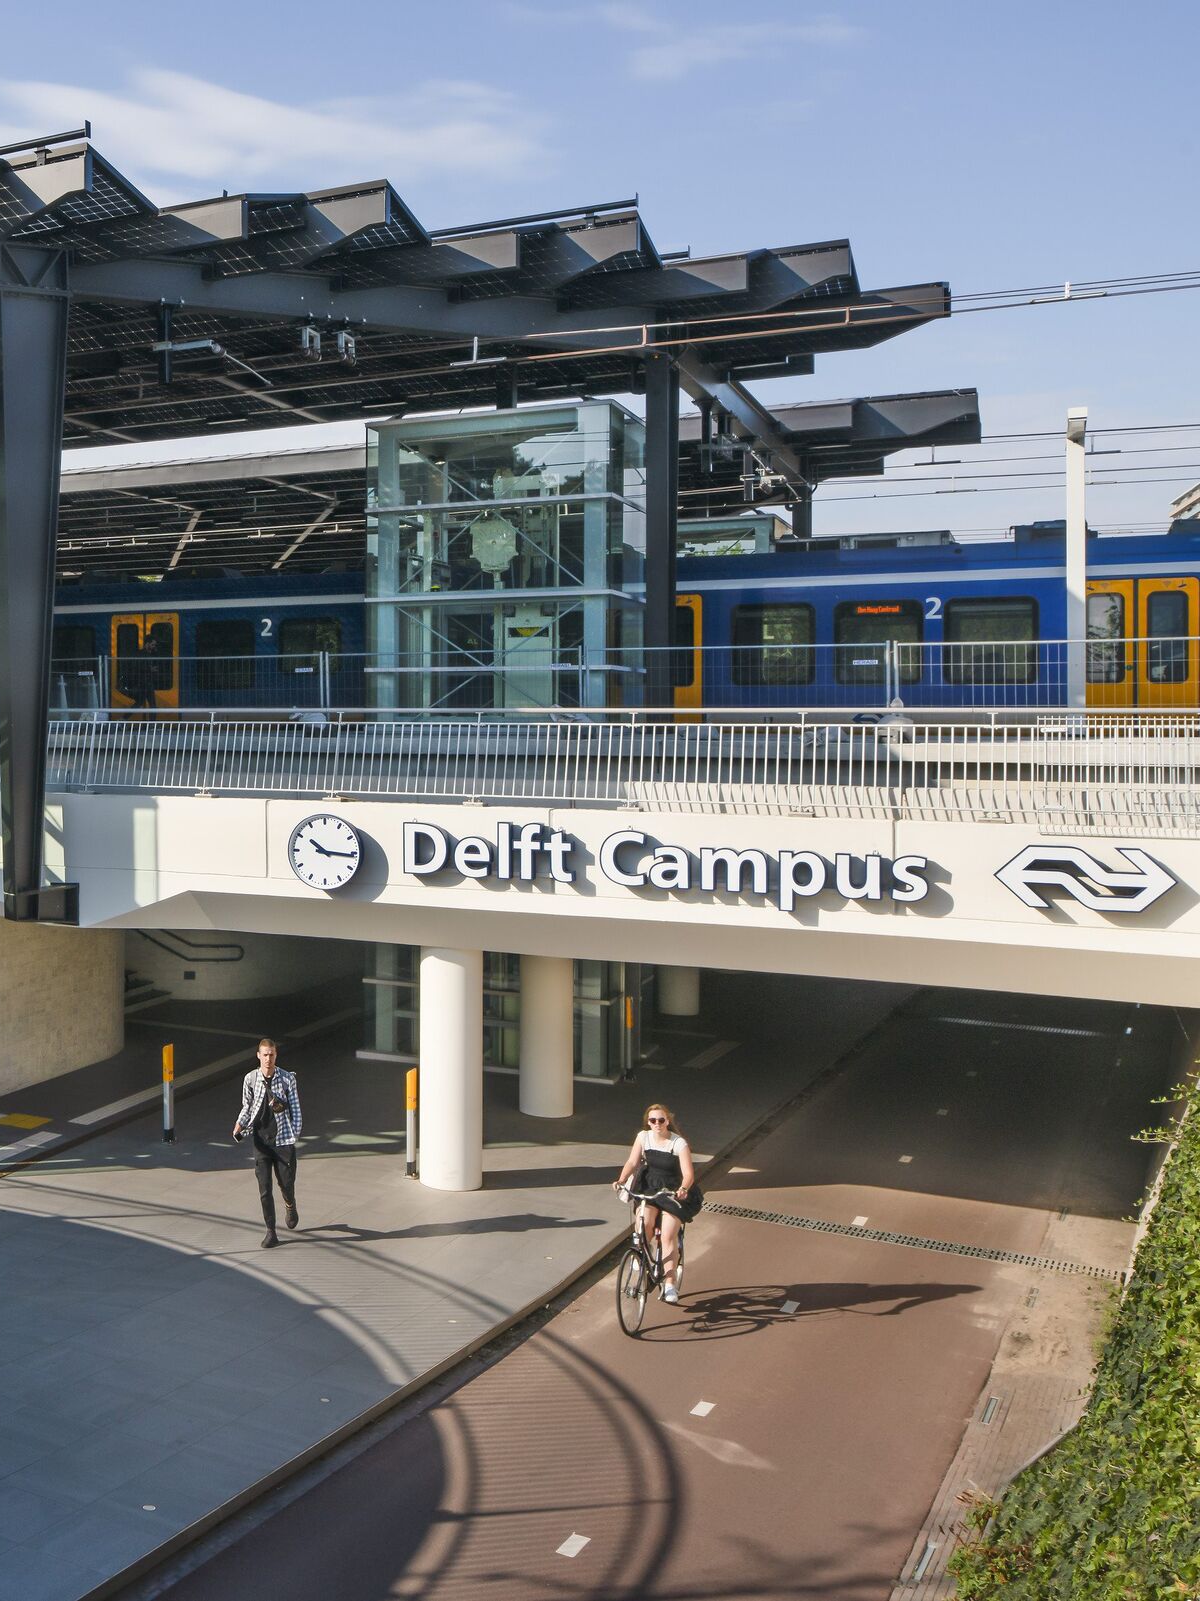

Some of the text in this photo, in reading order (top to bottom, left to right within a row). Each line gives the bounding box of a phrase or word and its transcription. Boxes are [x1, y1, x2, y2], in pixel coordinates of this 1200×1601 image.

[925, 597, 943, 620] 2
[261, 618, 273, 637] 2
[402, 821, 929, 912] Delft Campus
